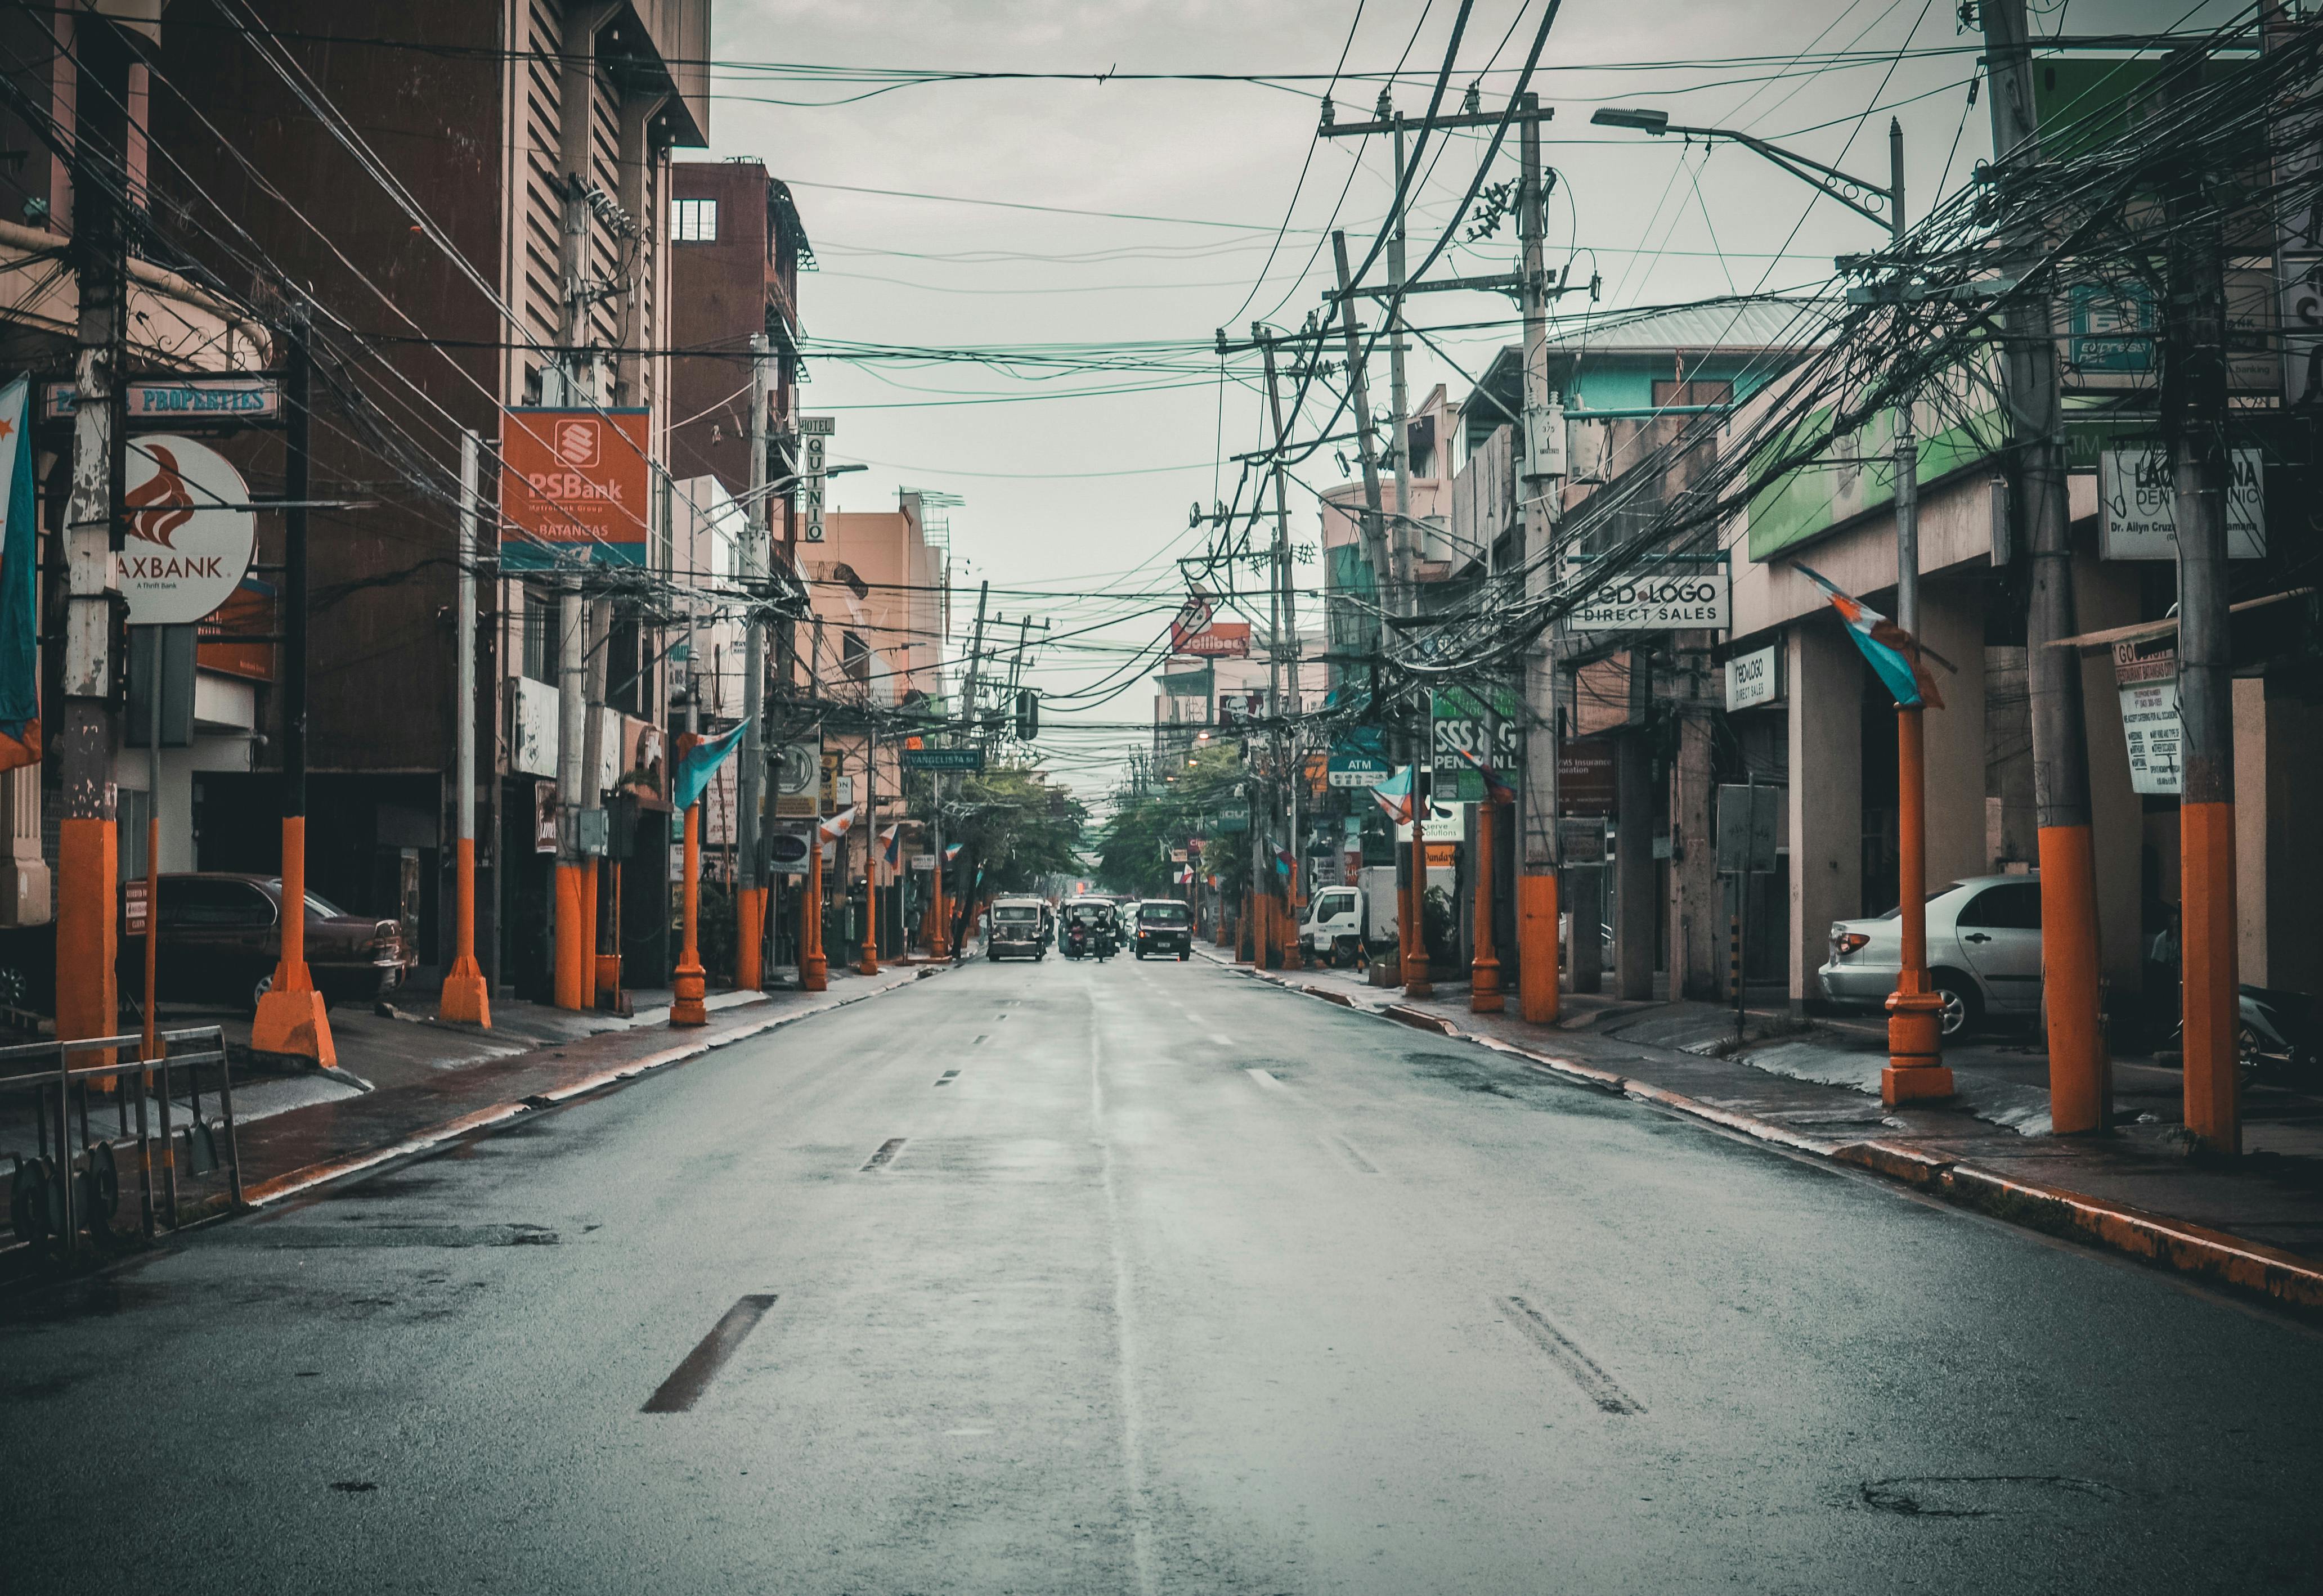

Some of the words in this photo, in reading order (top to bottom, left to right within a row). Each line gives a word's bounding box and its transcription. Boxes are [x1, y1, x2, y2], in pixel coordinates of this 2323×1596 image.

[2235, 366, 2270, 375] banking
[143, 388, 264, 412] PROPERTIES
[800, 421, 831, 432] HOTEL
[528, 473, 622, 499] PSBank
[809, 439, 823, 538] QUINIO
[539, 524, 608, 536] BATANGAS
[2111, 522, 2124, 532] Dr.
[2127, 522, 2149, 534] Ailyn
[117, 556, 223, 579] AXBANK
[1649, 583, 1716, 604] LOGO
[1584, 608, 1650, 621] DIRECT
[1659, 607, 1717, 621] SALES
[1736, 686, 1750, 702] DIRECT
[1751, 682, 1764, 698] SALES
[1435, 720, 1473, 753] SSS
[1348, 761, 1371, 770] ATM
